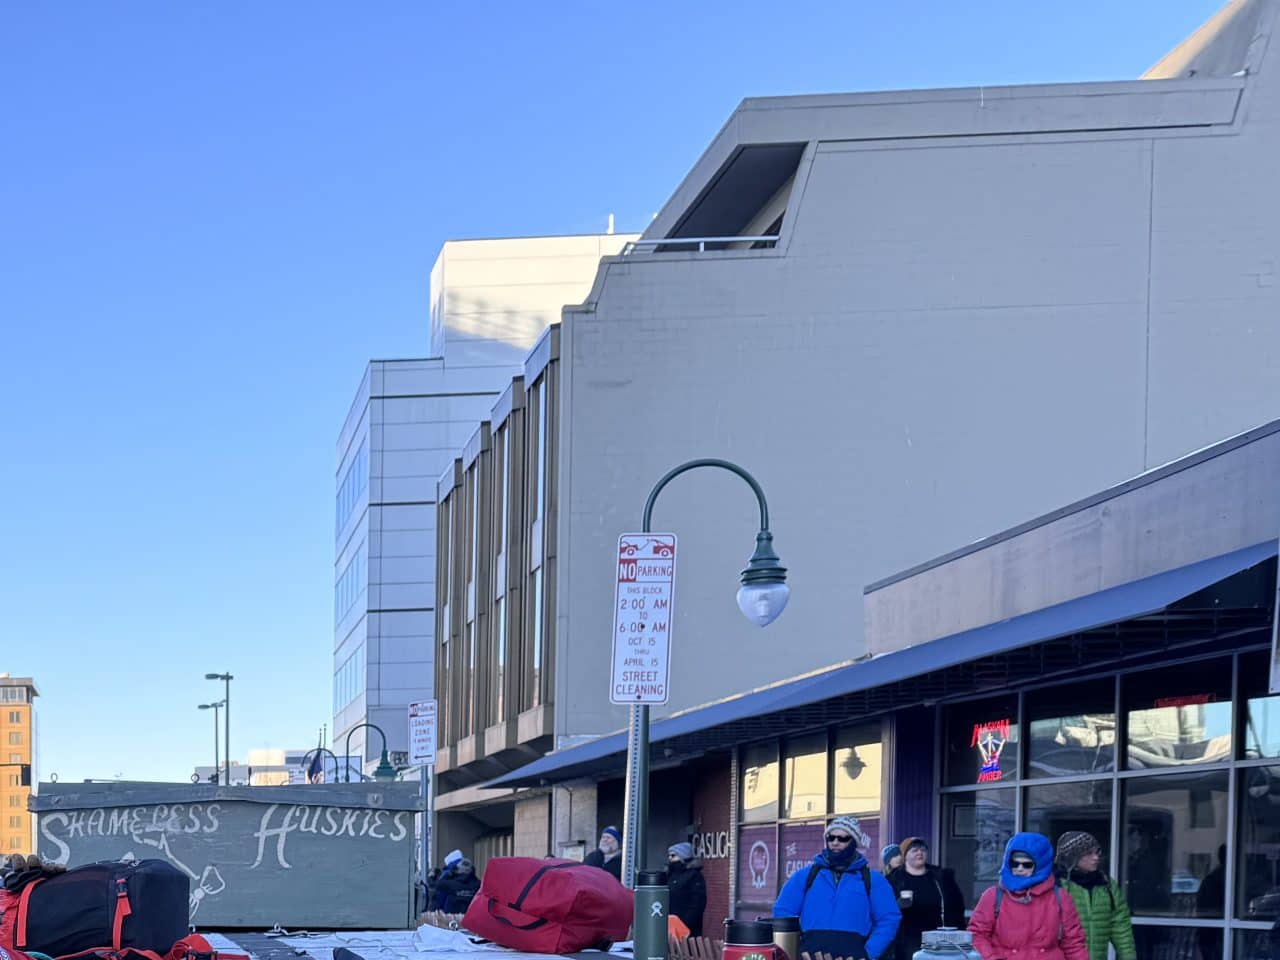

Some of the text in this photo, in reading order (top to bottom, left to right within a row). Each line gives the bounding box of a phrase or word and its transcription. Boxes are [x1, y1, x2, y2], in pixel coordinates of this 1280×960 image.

[619, 563, 672, 580] NO PARKING
[653, 600, 668, 609] AM
[639, 611, 648, 620] TO
[652, 622, 667, 633] AM
[628, 637, 656, 647] OCT 15
[624, 658, 645, 667] APRIL
[622, 671, 658, 682] STREET
[615, 684, 664, 696] CLEANING
[40, 803, 410, 869] SHAMELESS HUSKIES
[692, 831, 732, 859] GASLIGH
